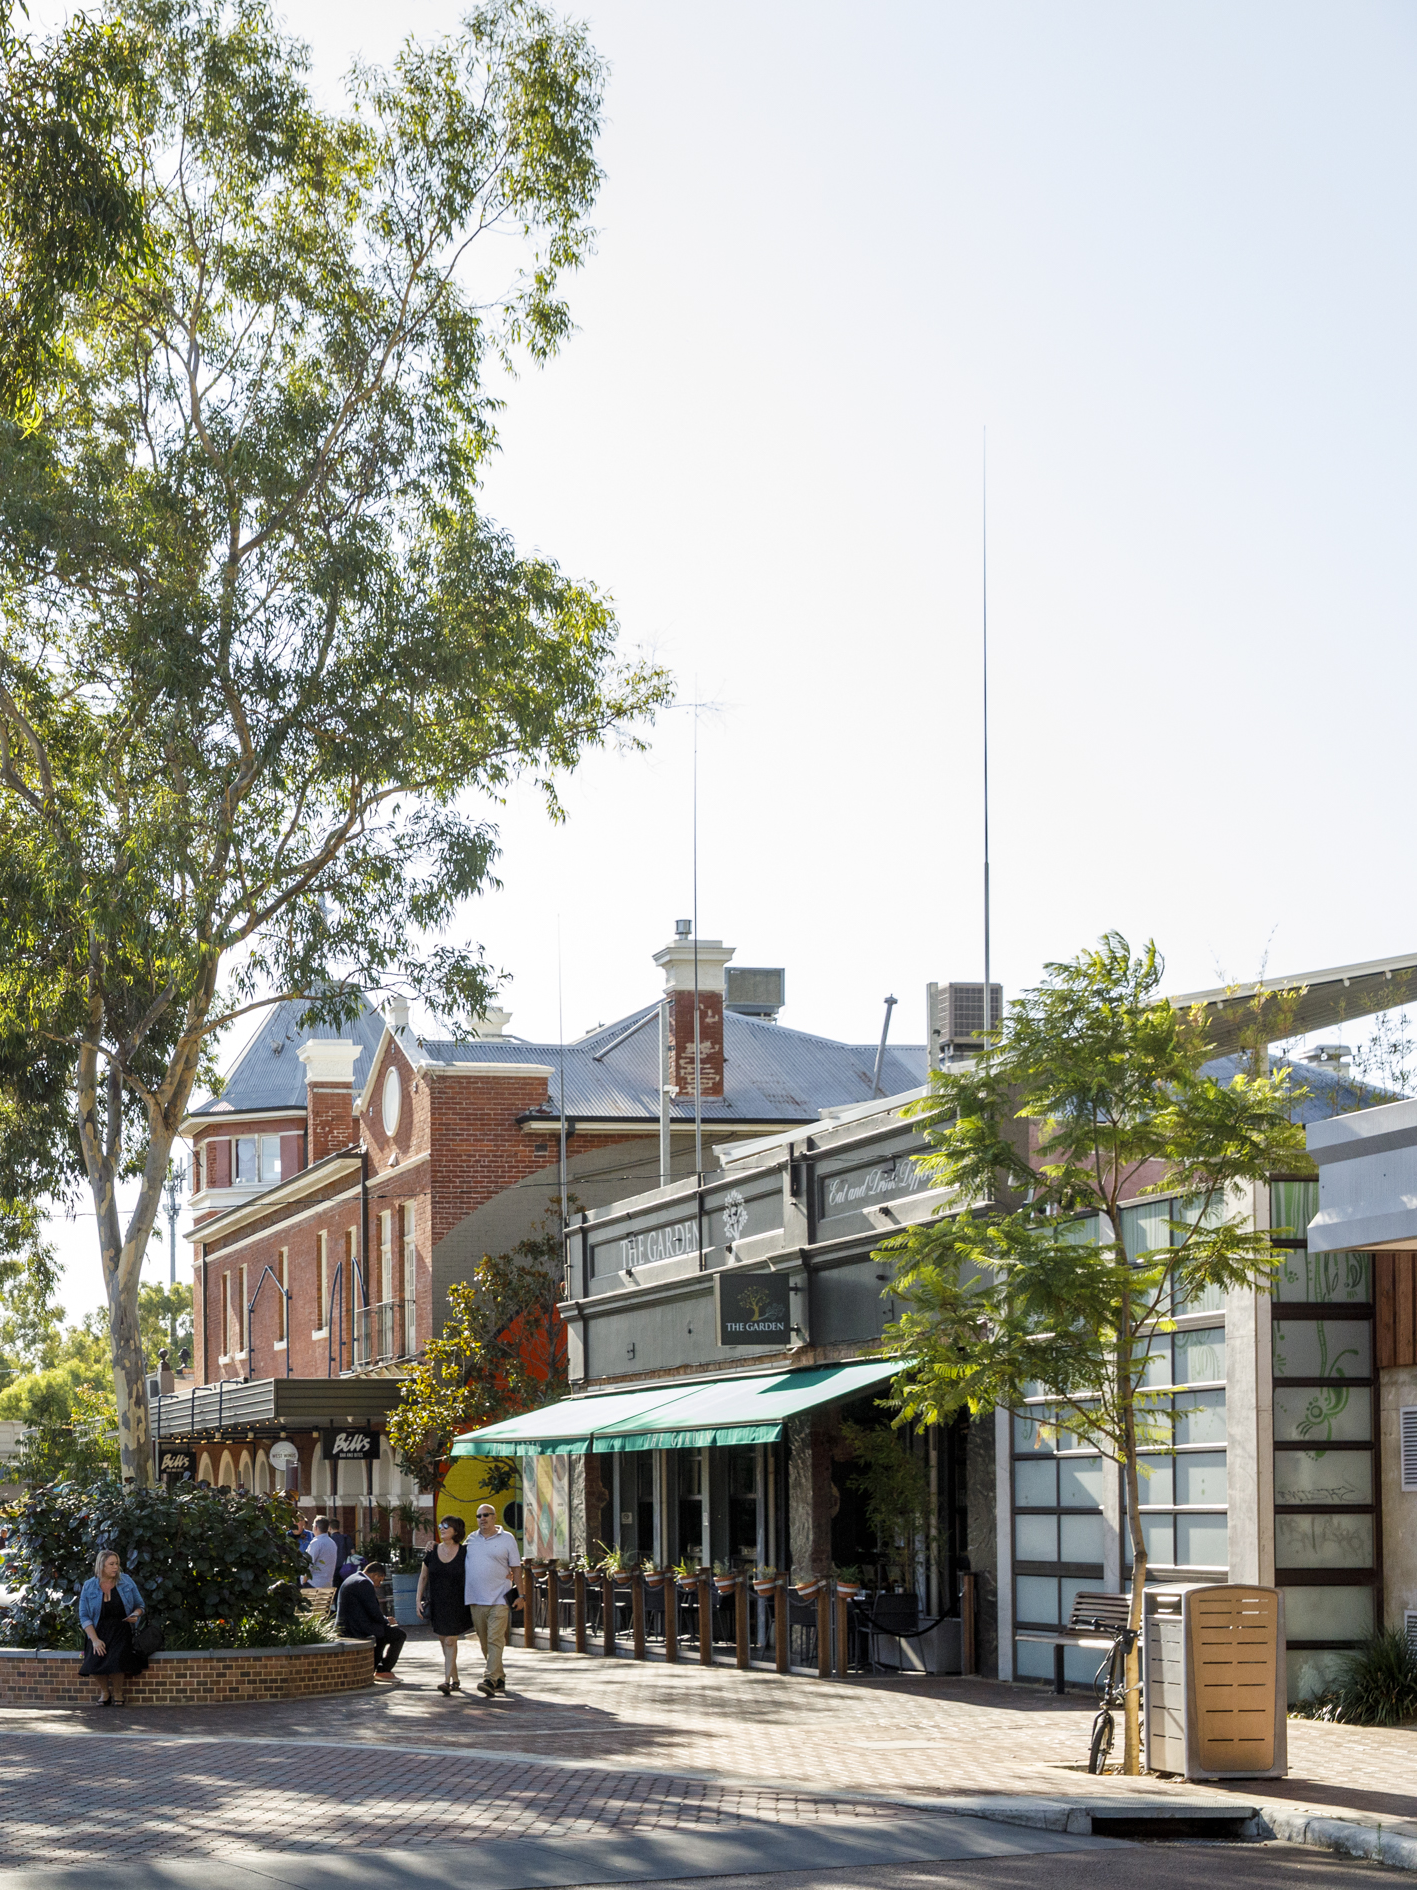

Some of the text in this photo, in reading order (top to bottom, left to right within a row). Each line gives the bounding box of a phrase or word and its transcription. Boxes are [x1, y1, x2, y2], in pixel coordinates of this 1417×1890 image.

[829, 1180, 848, 1205] Eat
[848, 1175, 868, 1200] and
[868, 1164, 900, 1196] Drink
[620, 1220, 700, 1269] THE GARDEN
[726, 1322, 784, 1331] THE GARDEN
[333, 1433, 370, 1455] Bill's
[645, 1429, 714, 1447] THE GARDEN
[161, 1453, 190, 1470] Bill's
